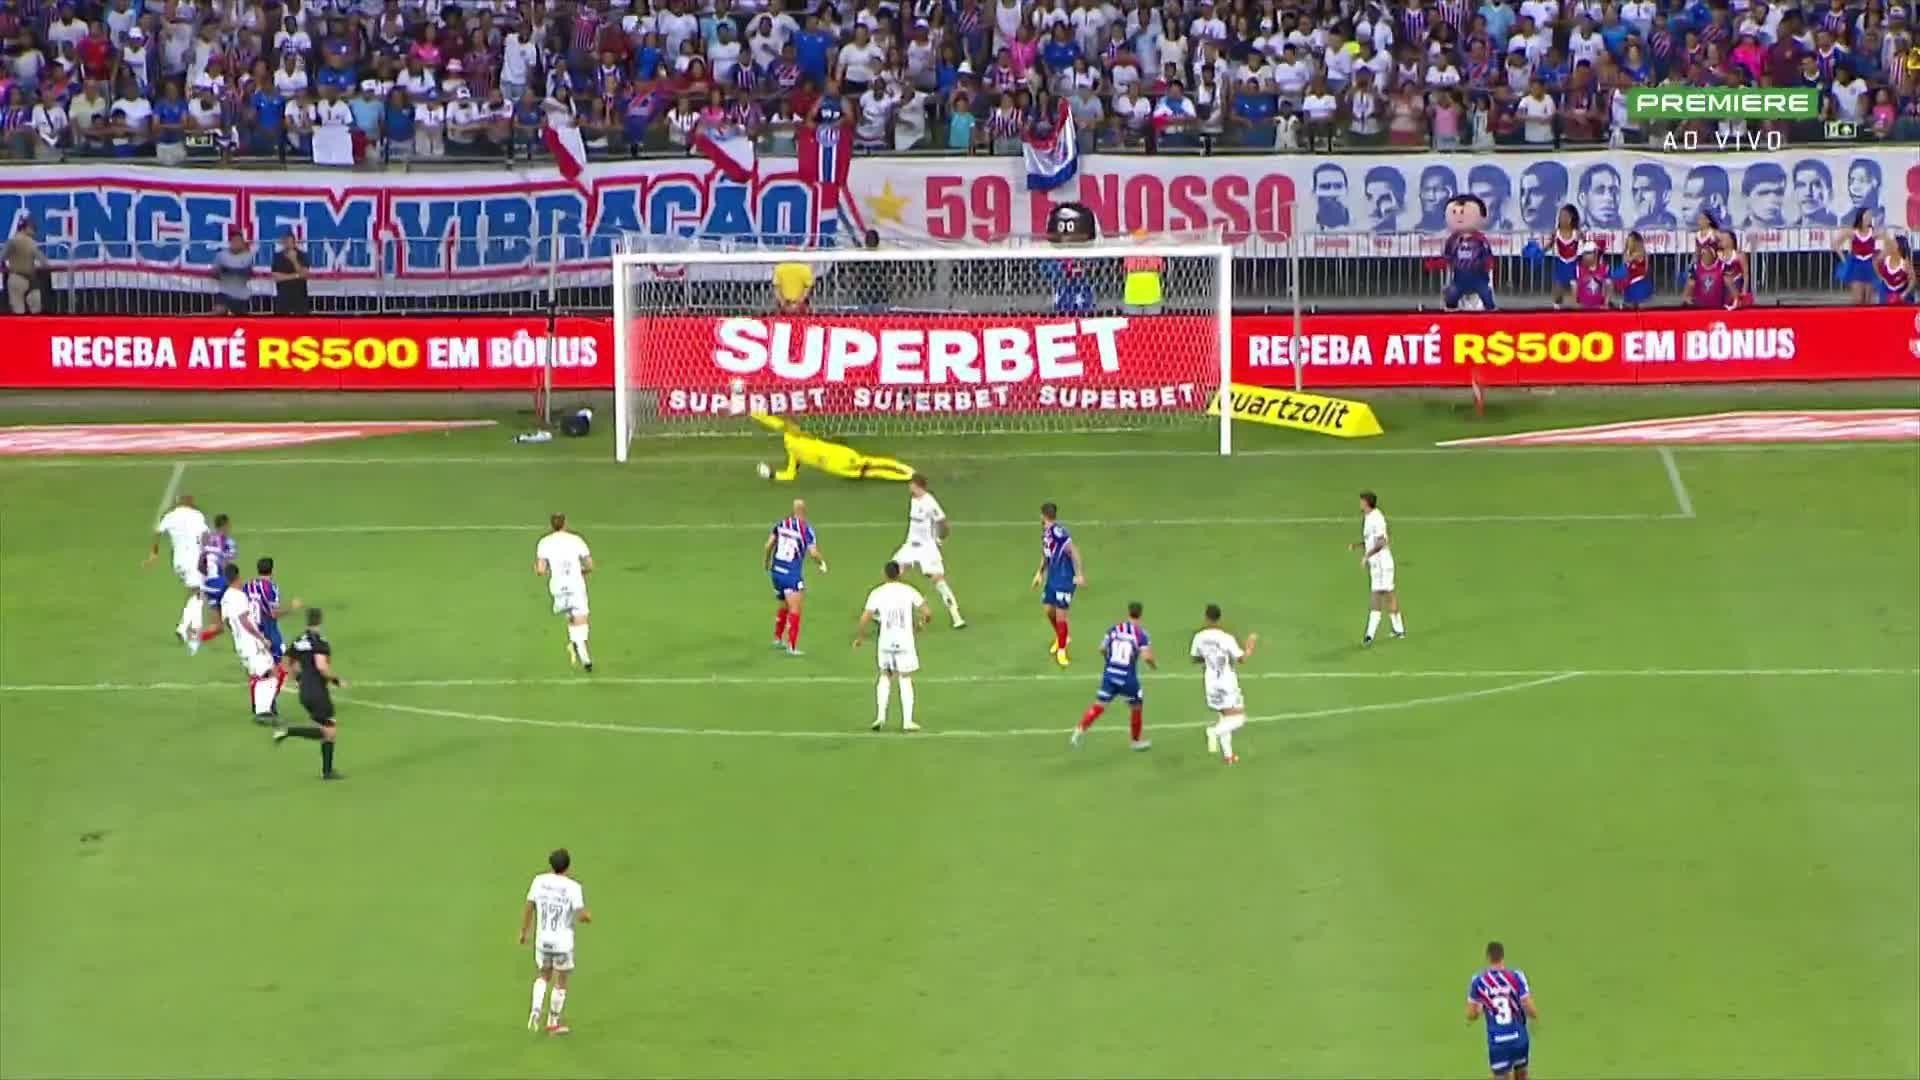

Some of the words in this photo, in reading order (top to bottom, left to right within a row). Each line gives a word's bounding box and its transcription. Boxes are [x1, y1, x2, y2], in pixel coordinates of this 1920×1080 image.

[254, 199, 374, 268] EM
[926, 175, 1012, 242] 59
[1080, 173, 1296, 243] NOSSO
[51, 336, 177, 368] RECEBA
[188, 328, 247, 368] ATÉ
[258, 337, 420, 371] R$500
[427, 336, 480, 368] EM
[714, 315, 1129, 384] SUPERBET
[1249, 334, 1374, 366] RECEBA
[1384, 324, 1442, 365] ATÉ
[1453, 332, 1614, 365] R$500
[1622, 330, 1676, 362] EM
[1684, 322, 1796, 360] BÔNUS
[1039, 383, 1195, 409] SUPERBET
